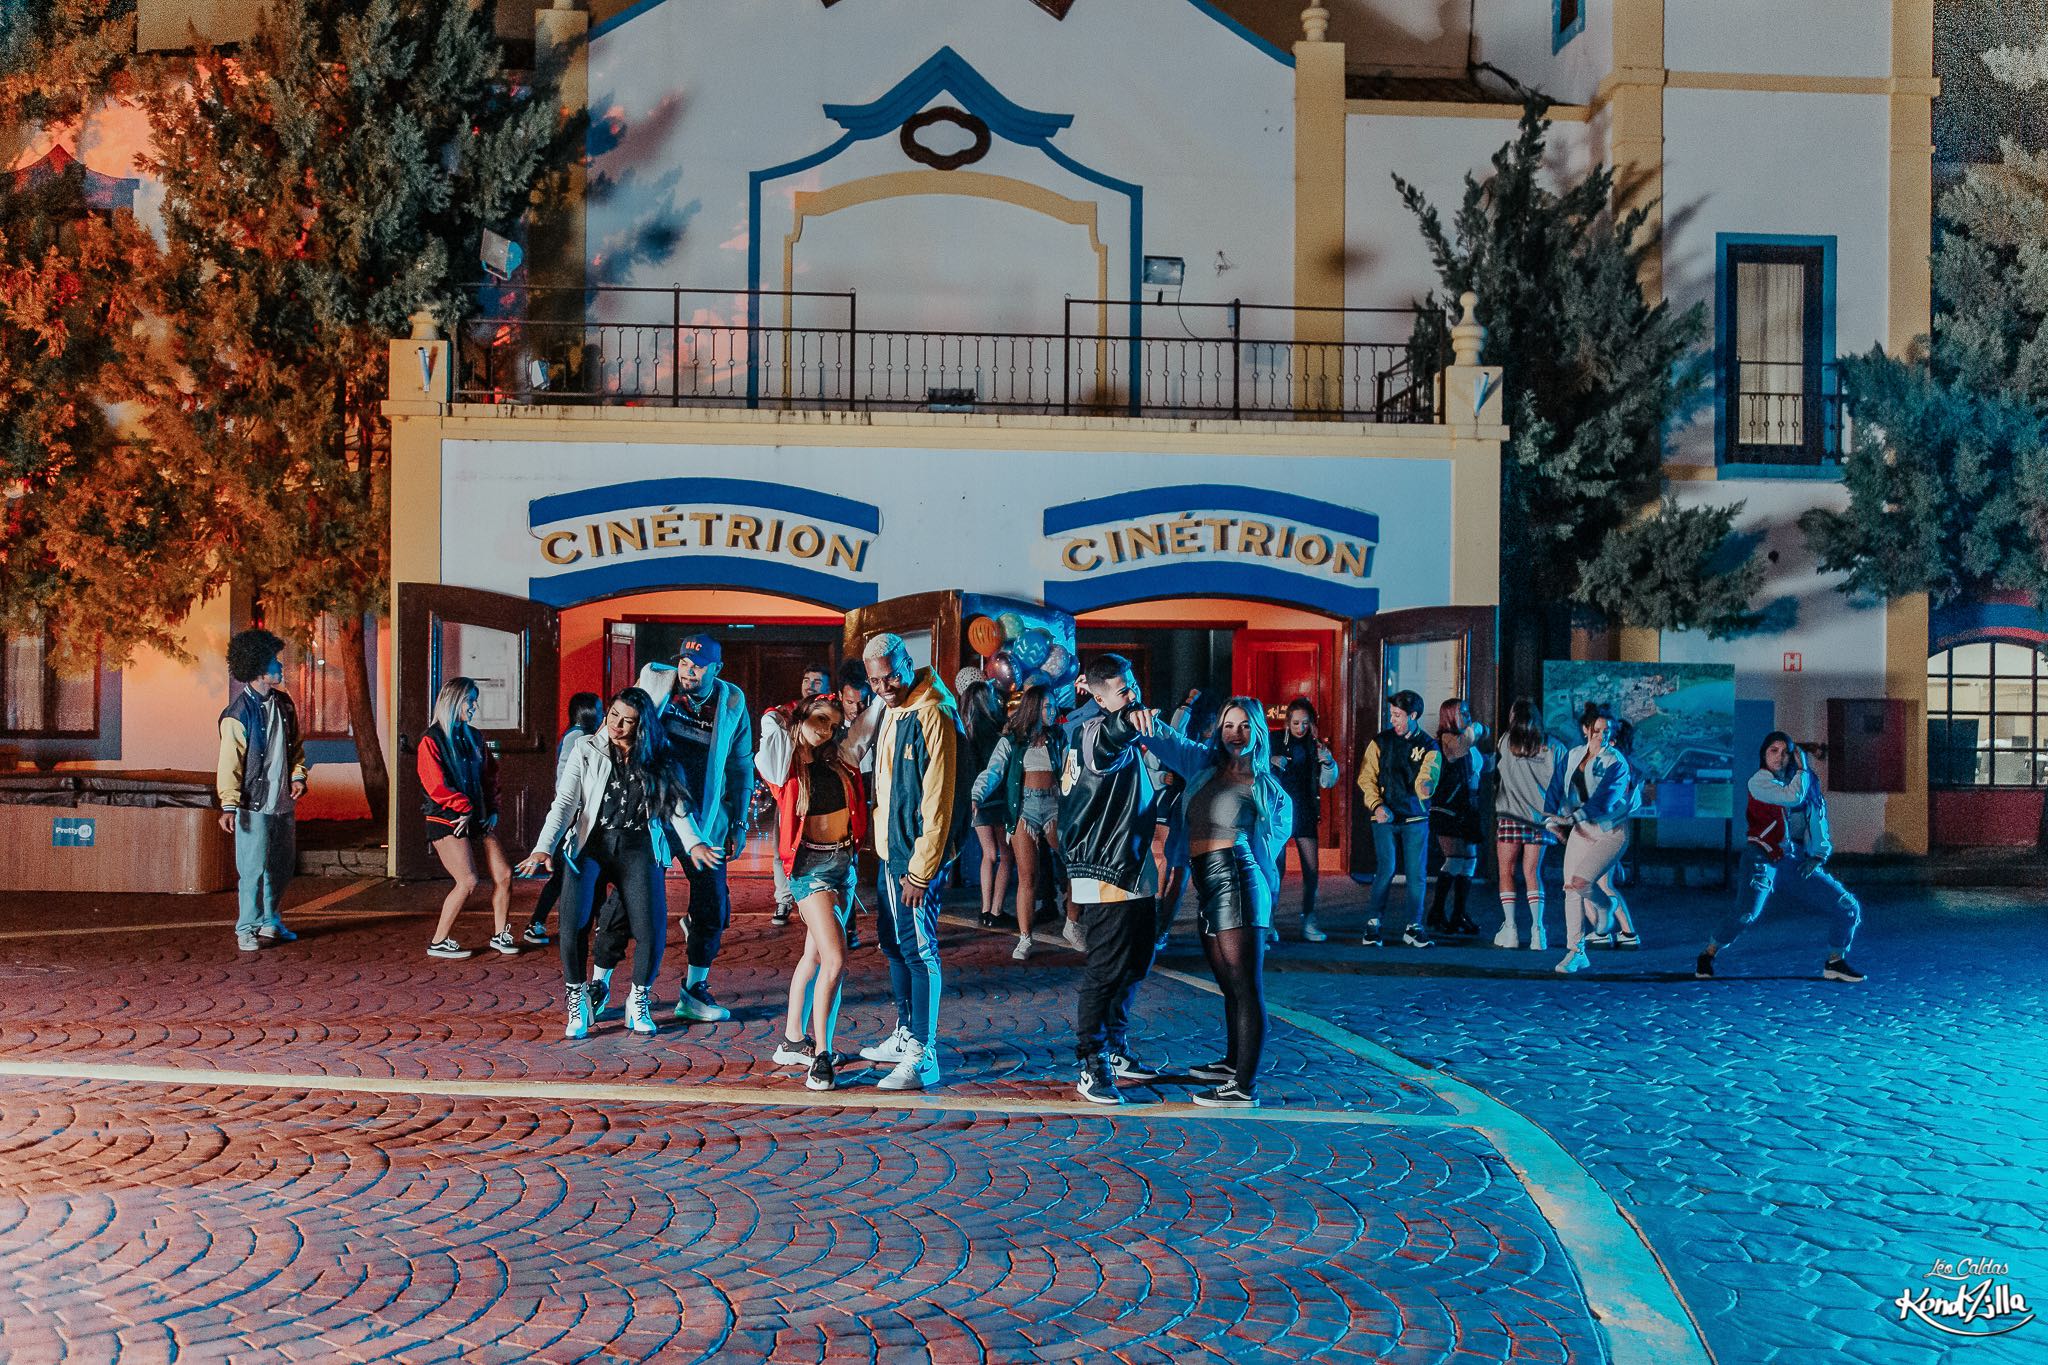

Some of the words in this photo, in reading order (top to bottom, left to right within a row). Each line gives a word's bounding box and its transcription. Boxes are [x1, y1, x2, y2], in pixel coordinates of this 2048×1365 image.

[540, 506, 868, 572] CINÉTRION
[1062, 511, 1371, 577] CINÉTRION
[685, 641, 703, 652] OKC
[667, 703, 713, 729] Champi
